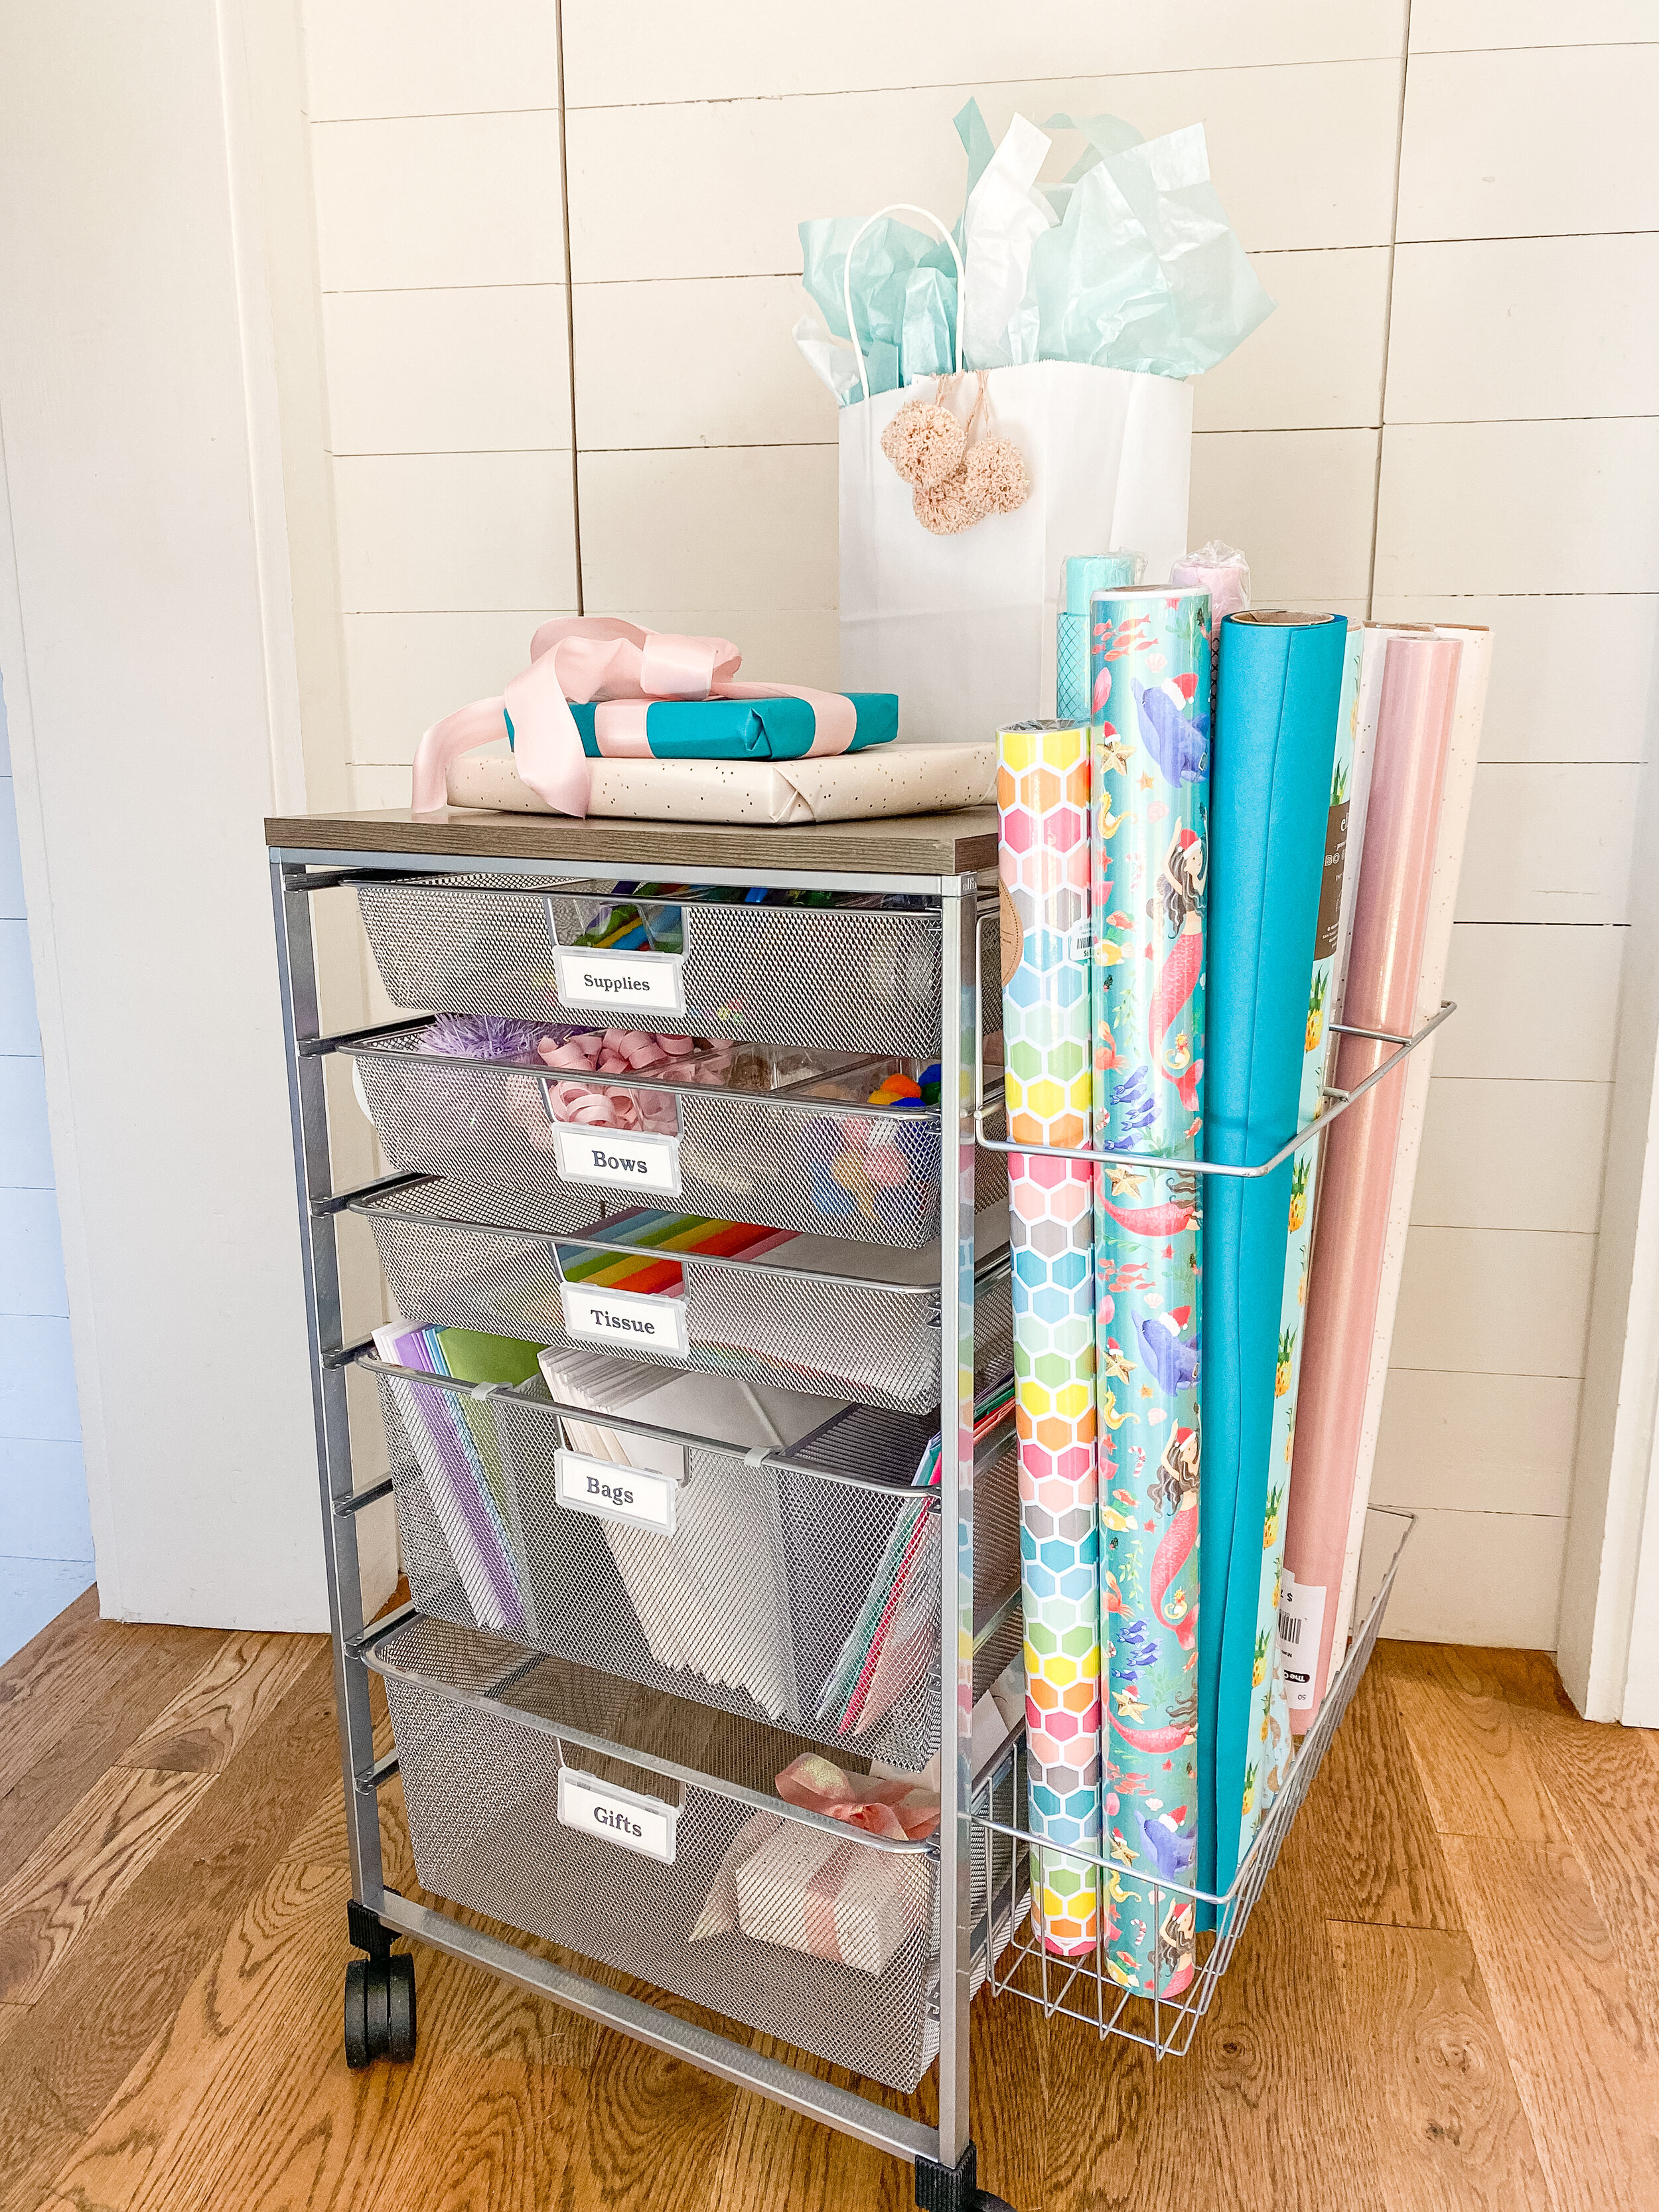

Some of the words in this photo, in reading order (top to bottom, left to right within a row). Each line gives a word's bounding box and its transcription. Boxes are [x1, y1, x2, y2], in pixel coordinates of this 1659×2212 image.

[584, 974, 650, 992] Supplies
[592, 1149, 648, 1174] Bows
[590, 1309, 655, 1335] Tissue
[587, 1477, 634, 1505] Bags
[593, 1806, 642, 1838] Gifts
